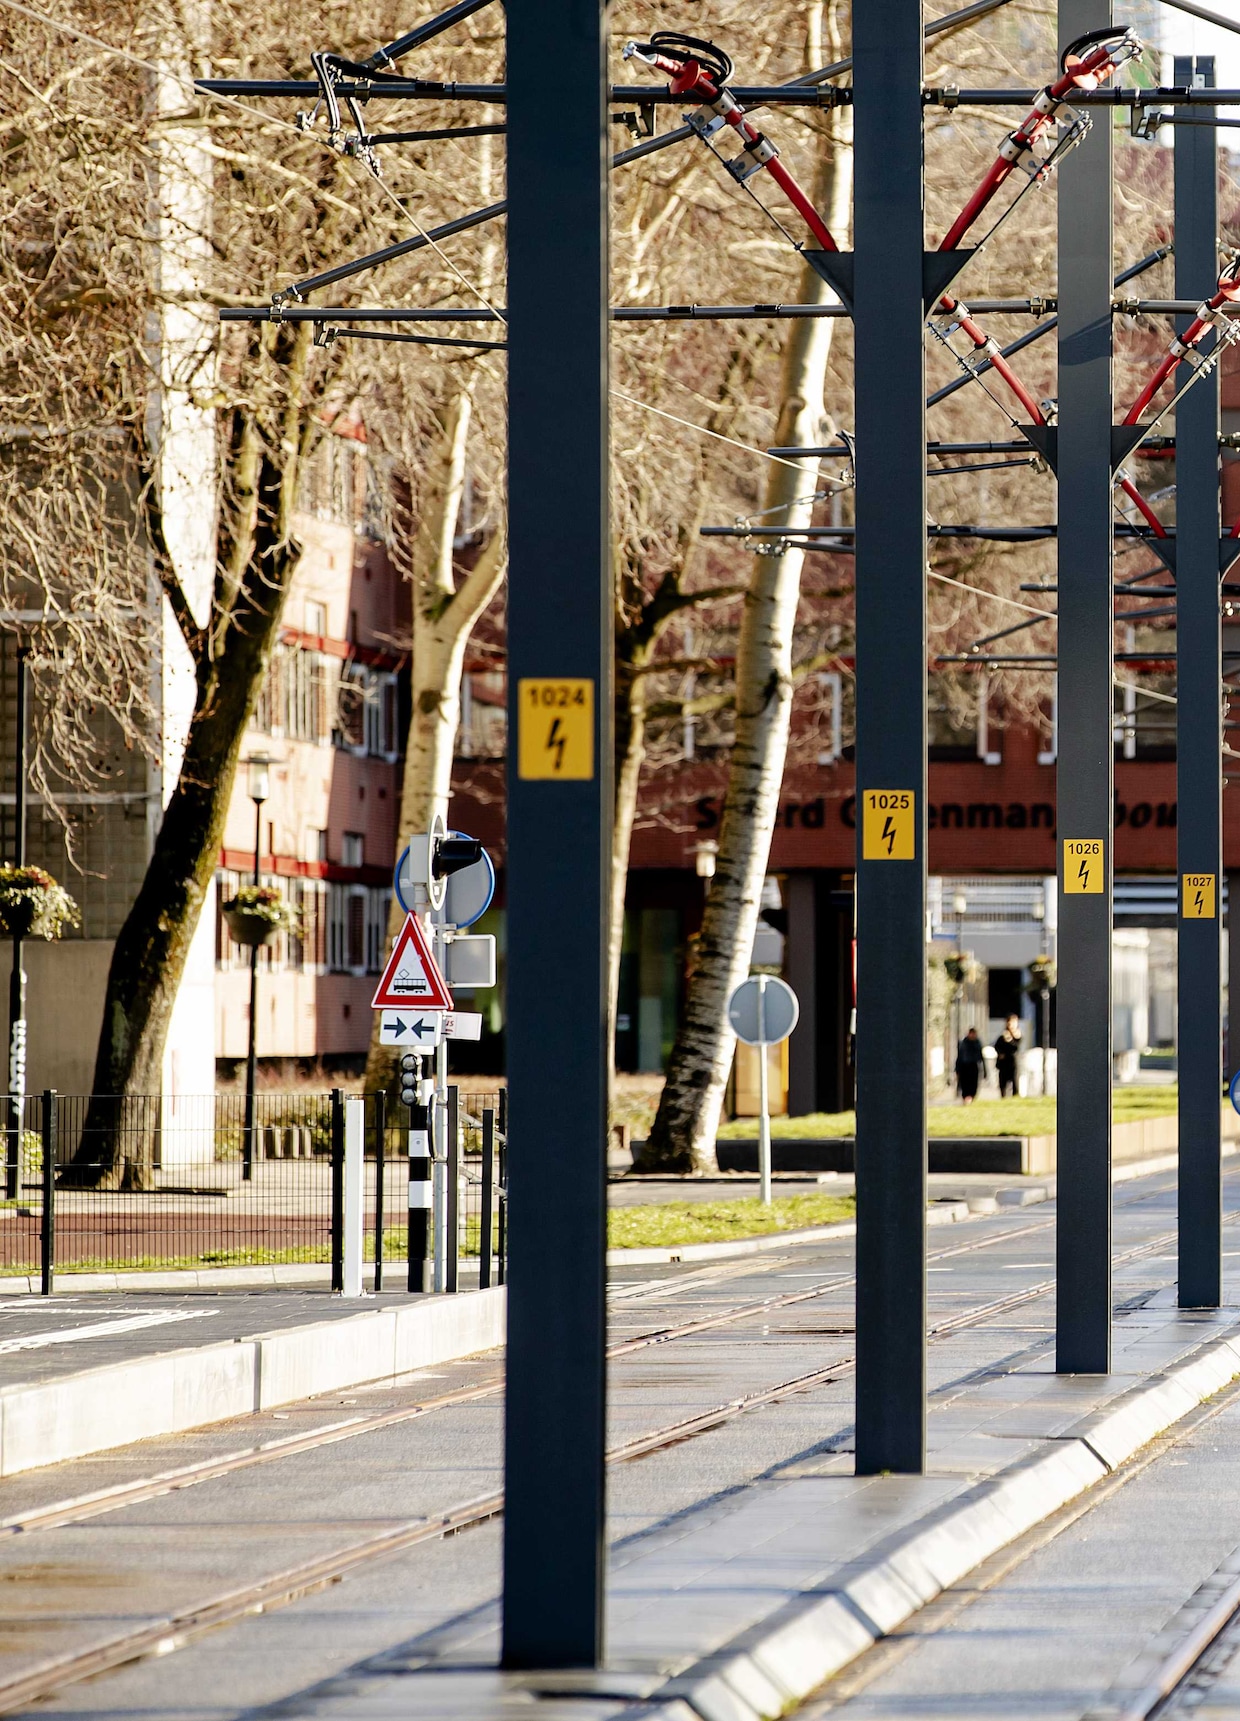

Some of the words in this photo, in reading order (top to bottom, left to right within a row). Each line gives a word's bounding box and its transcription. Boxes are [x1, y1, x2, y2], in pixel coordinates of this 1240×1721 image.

[528, 686, 585, 708] 1024
[869, 795, 910, 810] 1025
[1068, 843, 1100, 855] 1026
[1186, 877, 1212, 887] 1027
